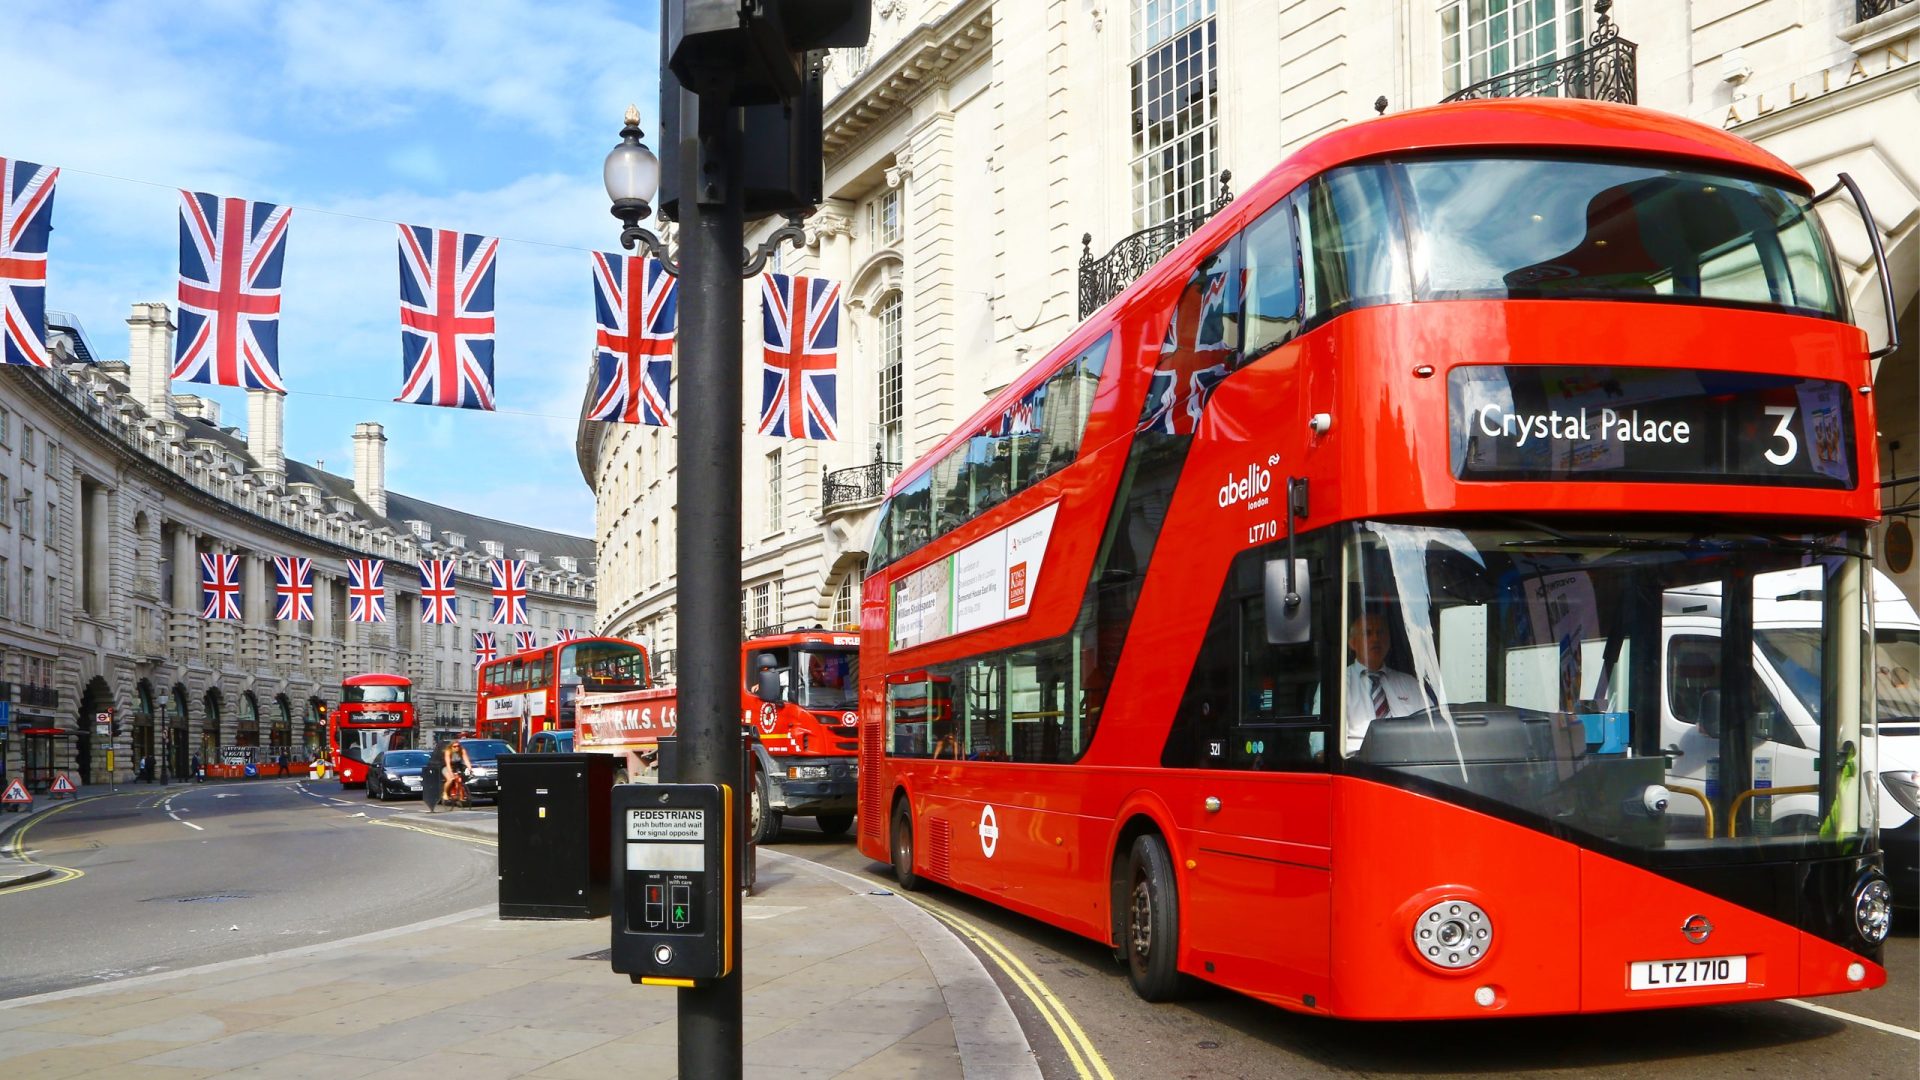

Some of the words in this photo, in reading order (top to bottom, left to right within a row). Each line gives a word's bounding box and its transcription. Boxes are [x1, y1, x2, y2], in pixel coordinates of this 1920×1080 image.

[1479, 403, 1591, 447] Crystal
[1601, 408, 1691, 444] Palace
[1763, 405, 1799, 467] 3
[1218, 463, 1271, 508] abellio
[1247, 497, 1269, 511] london
[1248, 519, 1277, 544] LT710
[388, 713, 401, 722] 159
[660, 706, 677, 728] Lt
[1209, 742, 1221, 756] 321
[633, 811, 702, 820] PEDESTRIANS
[633, 821, 650, 829] push
[637, 829, 646, 837] for
[647, 829, 668, 837] signal
[1648, 963, 1687, 984] LTZ
[1693, 960, 1729, 981] 1710
